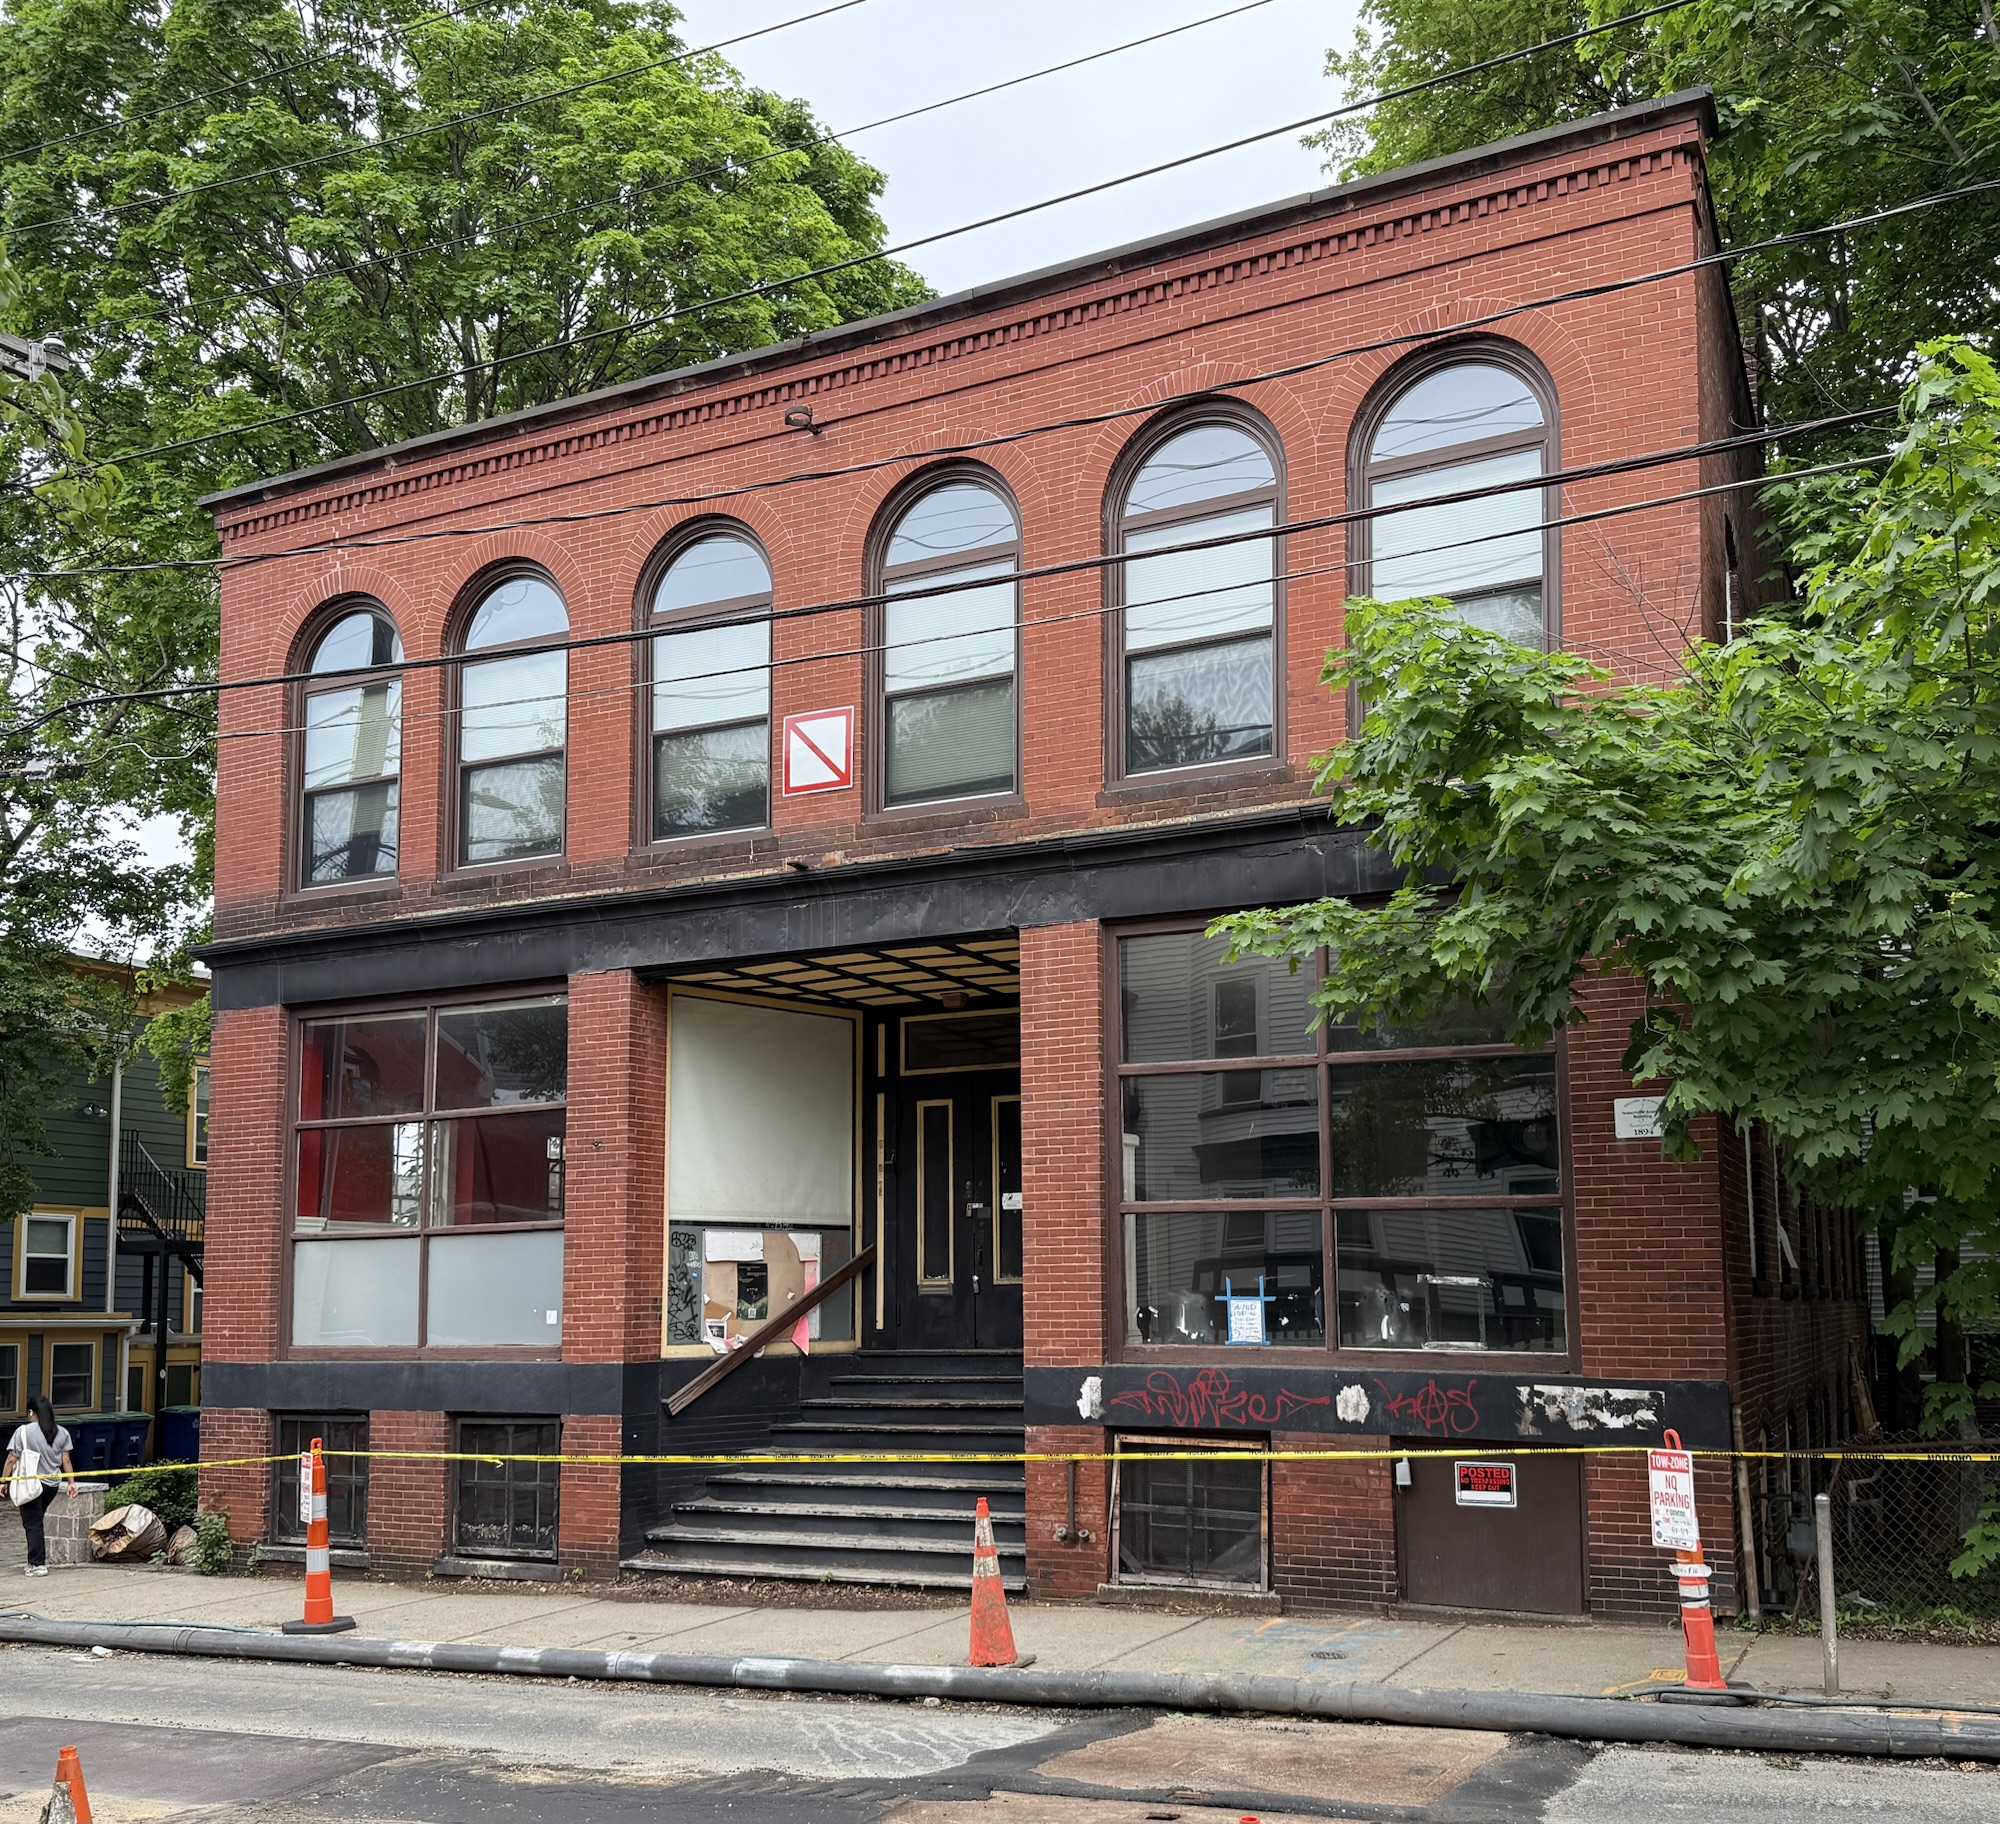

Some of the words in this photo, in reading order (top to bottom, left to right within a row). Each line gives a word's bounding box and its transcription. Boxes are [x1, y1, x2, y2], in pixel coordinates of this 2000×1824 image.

[1651, 1454, 1689, 1470] TOW-ZONE
[1460, 1466, 1510, 1479] POSTED
[1470, 1477, 1510, 1485] TRESPASSING
[1665, 1474, 1678, 1490] NO
[1654, 1490, 1690, 1510] PARKING
